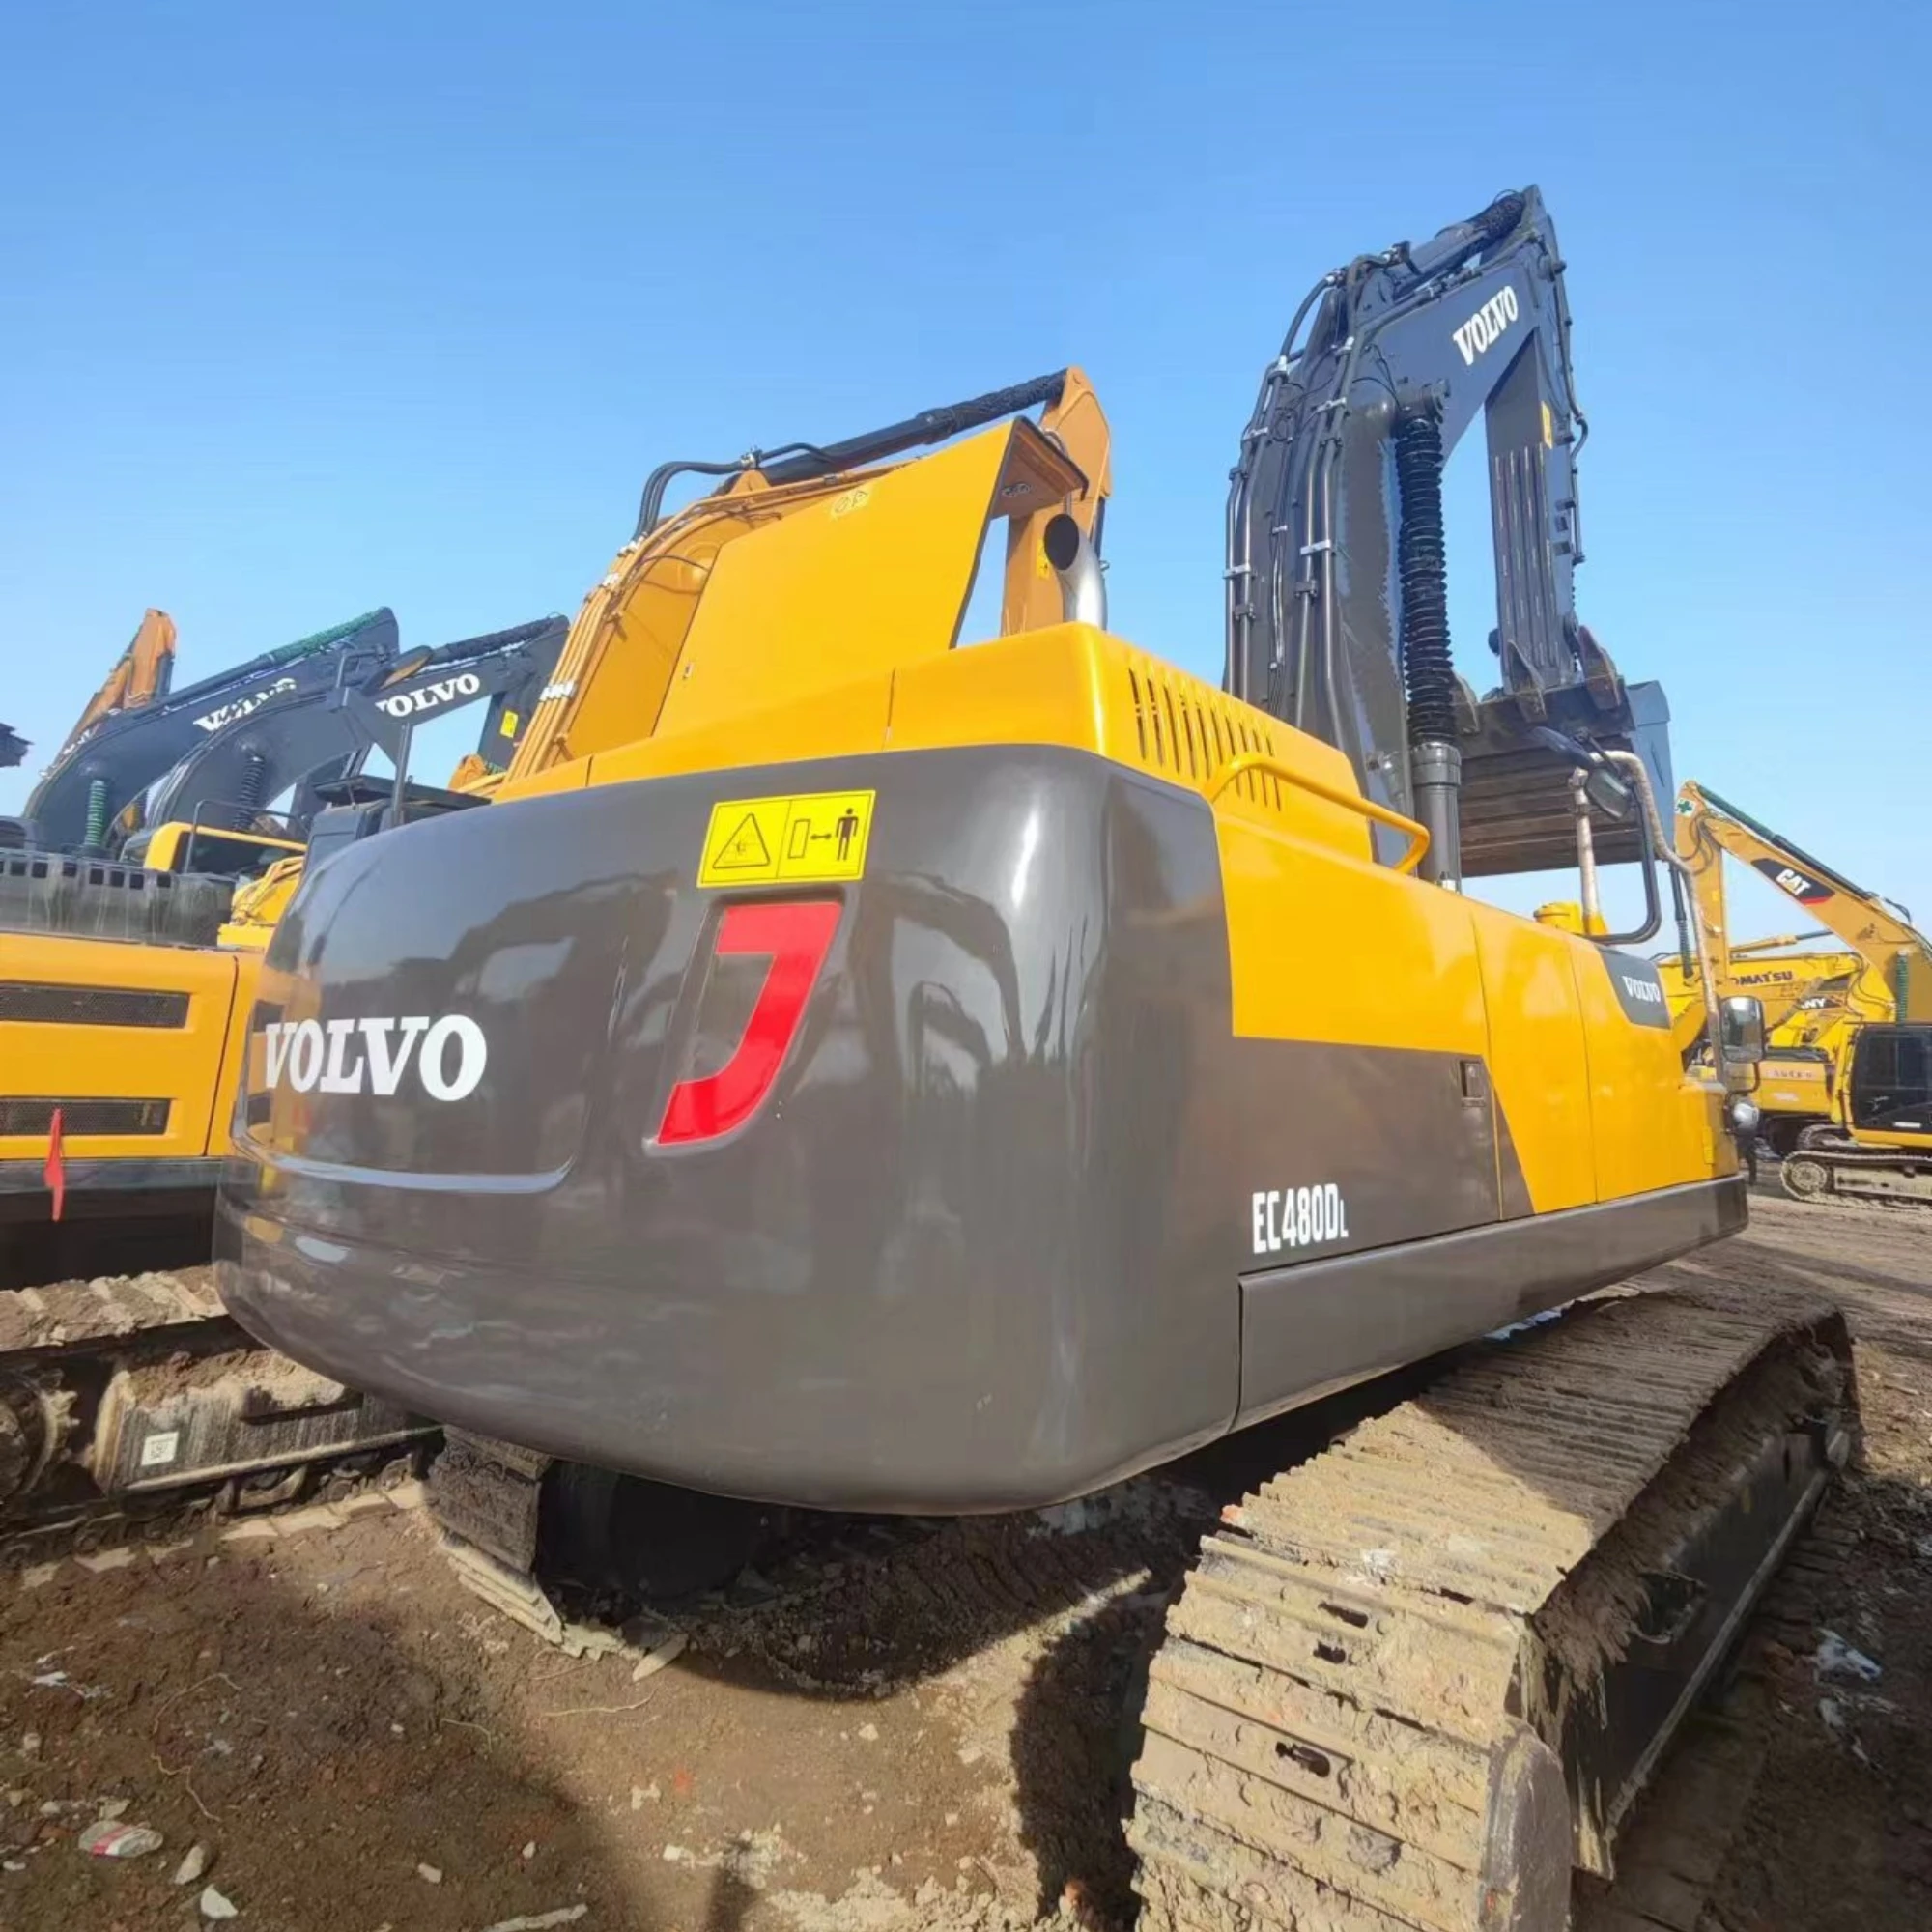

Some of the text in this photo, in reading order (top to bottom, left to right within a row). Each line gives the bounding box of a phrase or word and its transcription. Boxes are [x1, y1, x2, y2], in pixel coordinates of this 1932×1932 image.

[1452, 285, 1518, 366] VOLVO
[1776, 868, 1811, 895] CAT
[1622, 976, 1661, 1002] VOLVO
[266, 1014, 487, 1101] VOLVO
